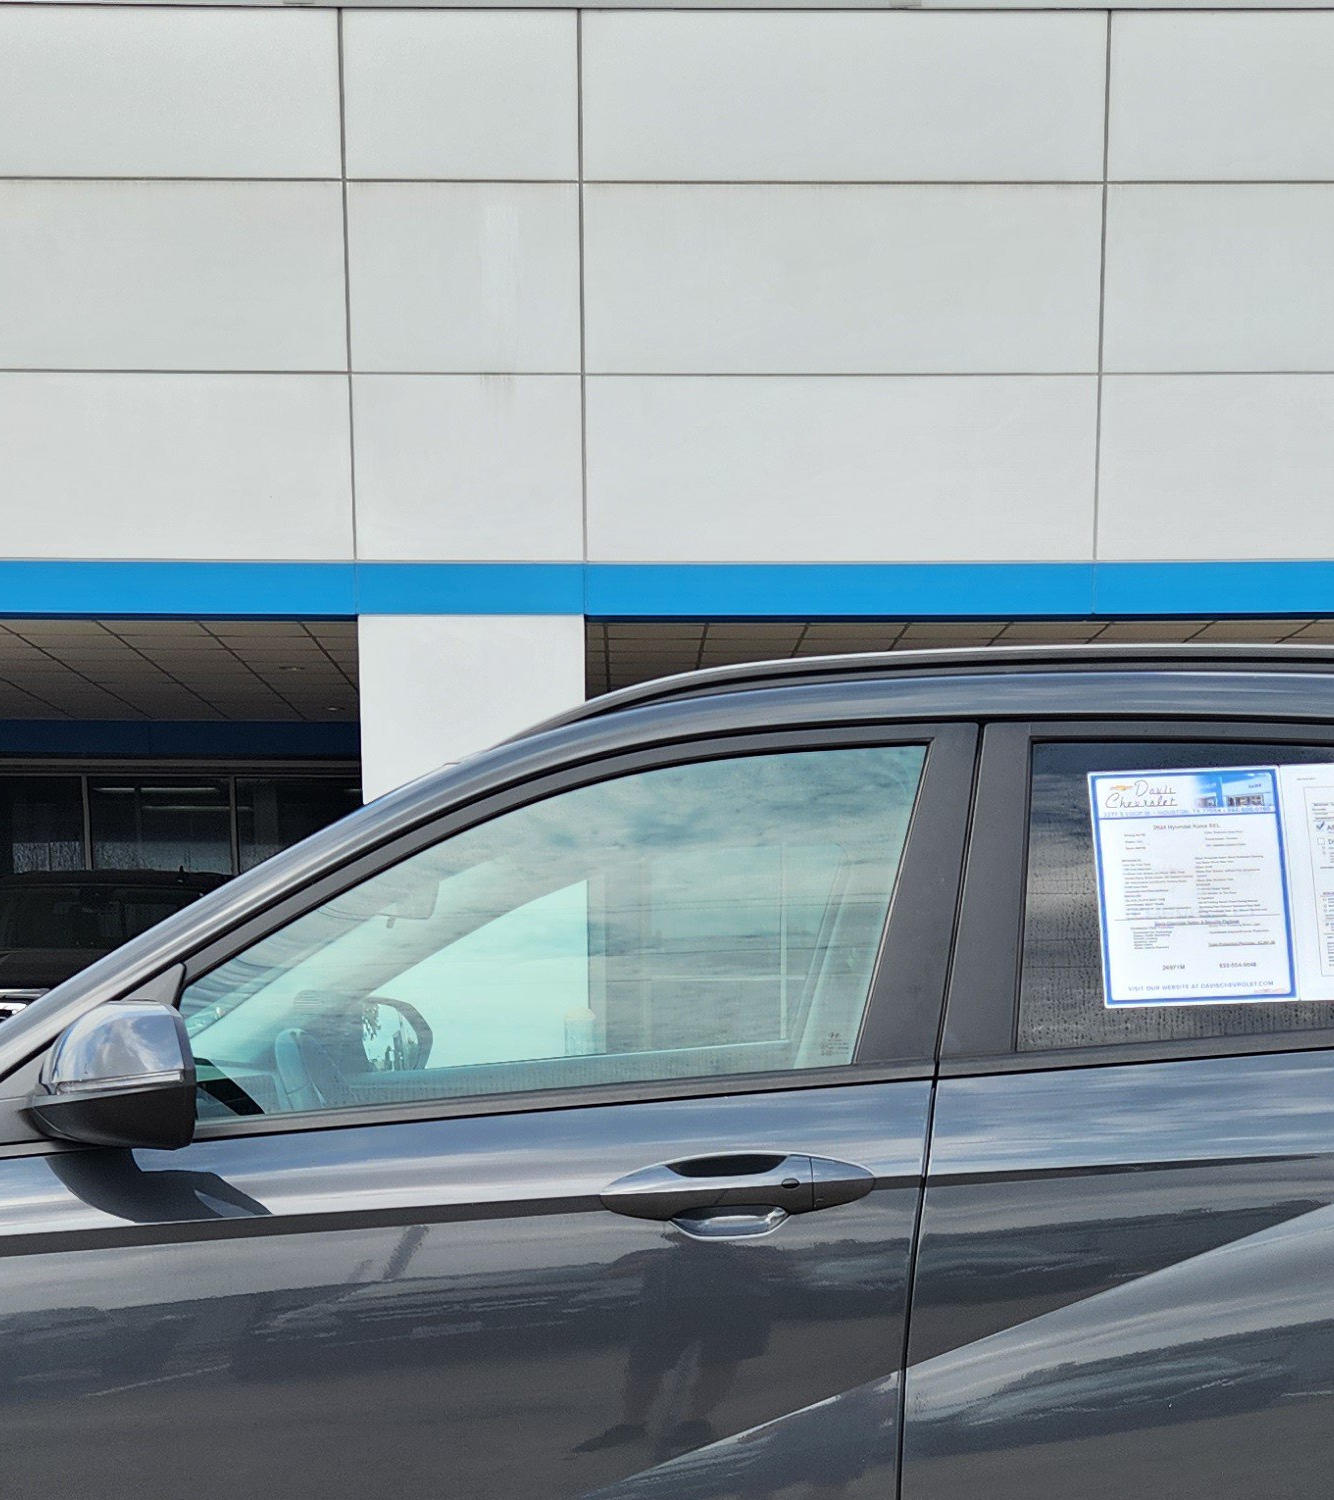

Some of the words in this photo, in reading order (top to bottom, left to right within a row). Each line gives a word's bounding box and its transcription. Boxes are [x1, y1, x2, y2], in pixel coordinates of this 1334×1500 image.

[1134, 779, 1176, 797] Davis
[1105, 792, 1178, 808] Chevrolet
[1161, 983, 1189, 991] WEBSITE
[1200, 980, 1274, 989] DAVISCHEVROLET.COM
